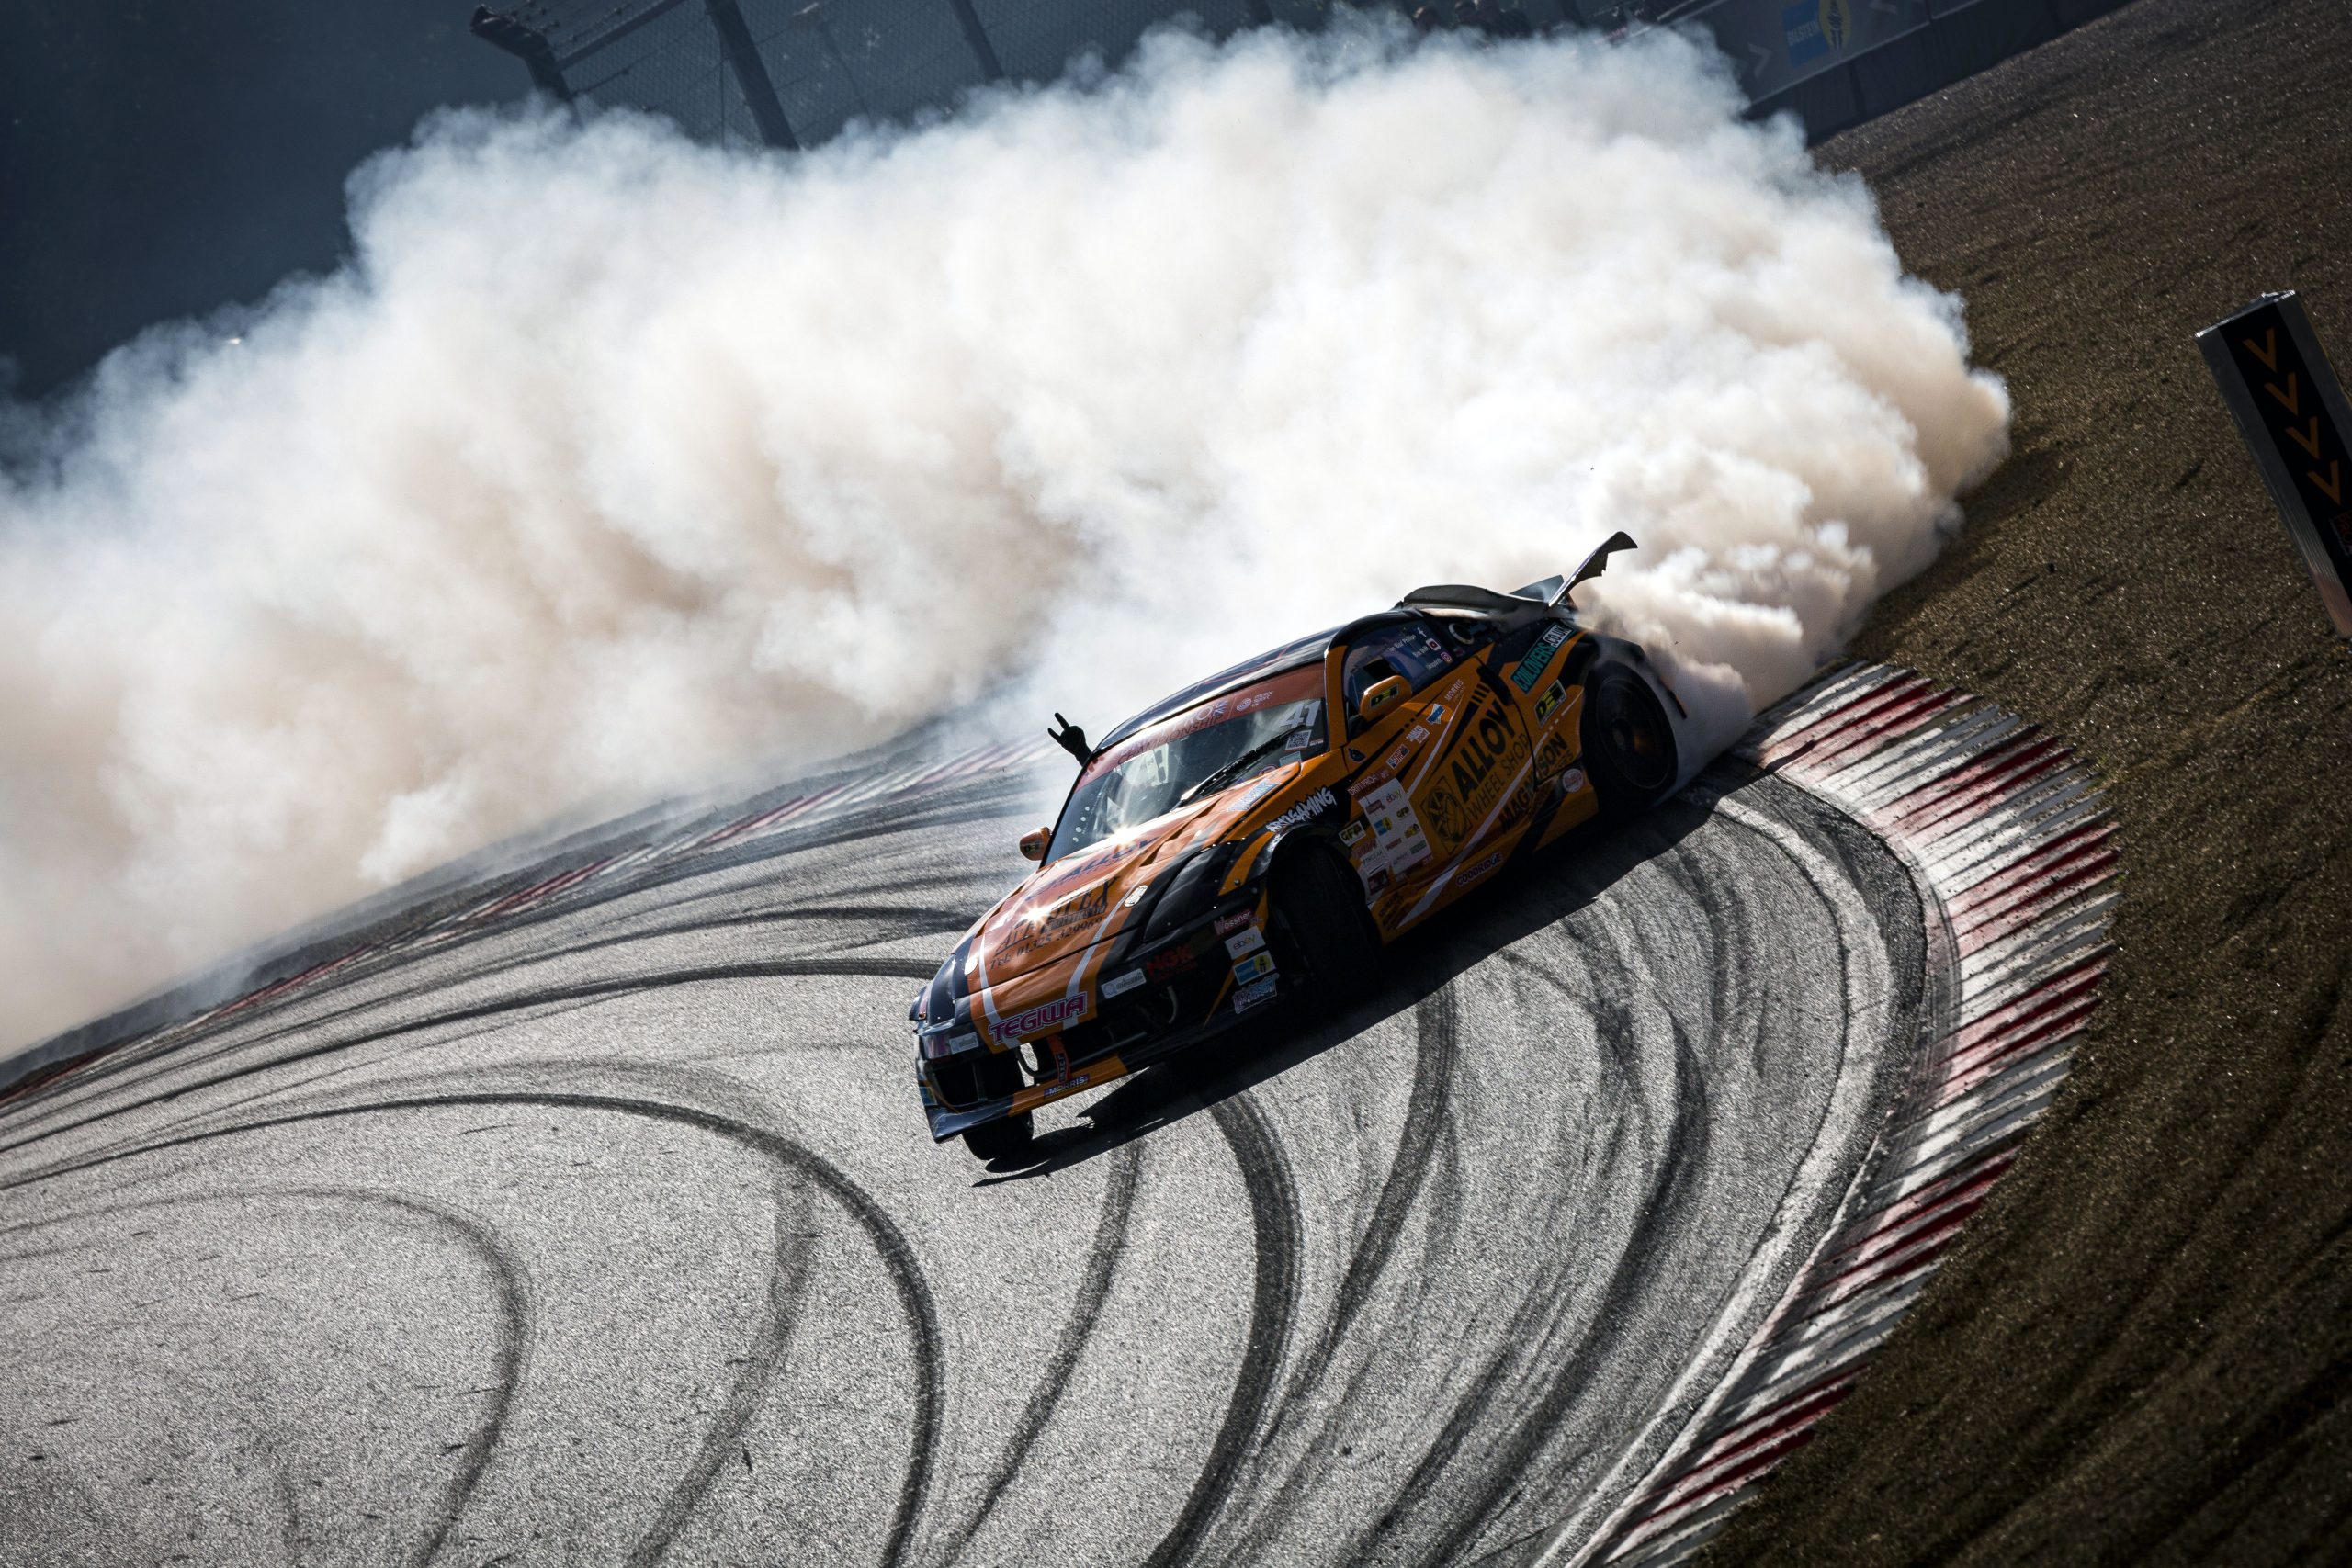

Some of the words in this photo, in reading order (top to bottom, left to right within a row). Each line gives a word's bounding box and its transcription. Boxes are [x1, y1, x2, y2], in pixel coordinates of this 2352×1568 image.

[1444, 679, 1464, 701] MORRIS
[1279, 700, 1321, 728] 41
[1451, 700, 1515, 804] ALLOY
[1467, 772, 1504, 821] WHEEL
[1500, 733, 1530, 776] SHOP
[1457, 853, 1501, 886] GOODRIDGE
[1233, 934, 1257, 951] ebay
[989, 992, 1088, 1045] TEGIWA
